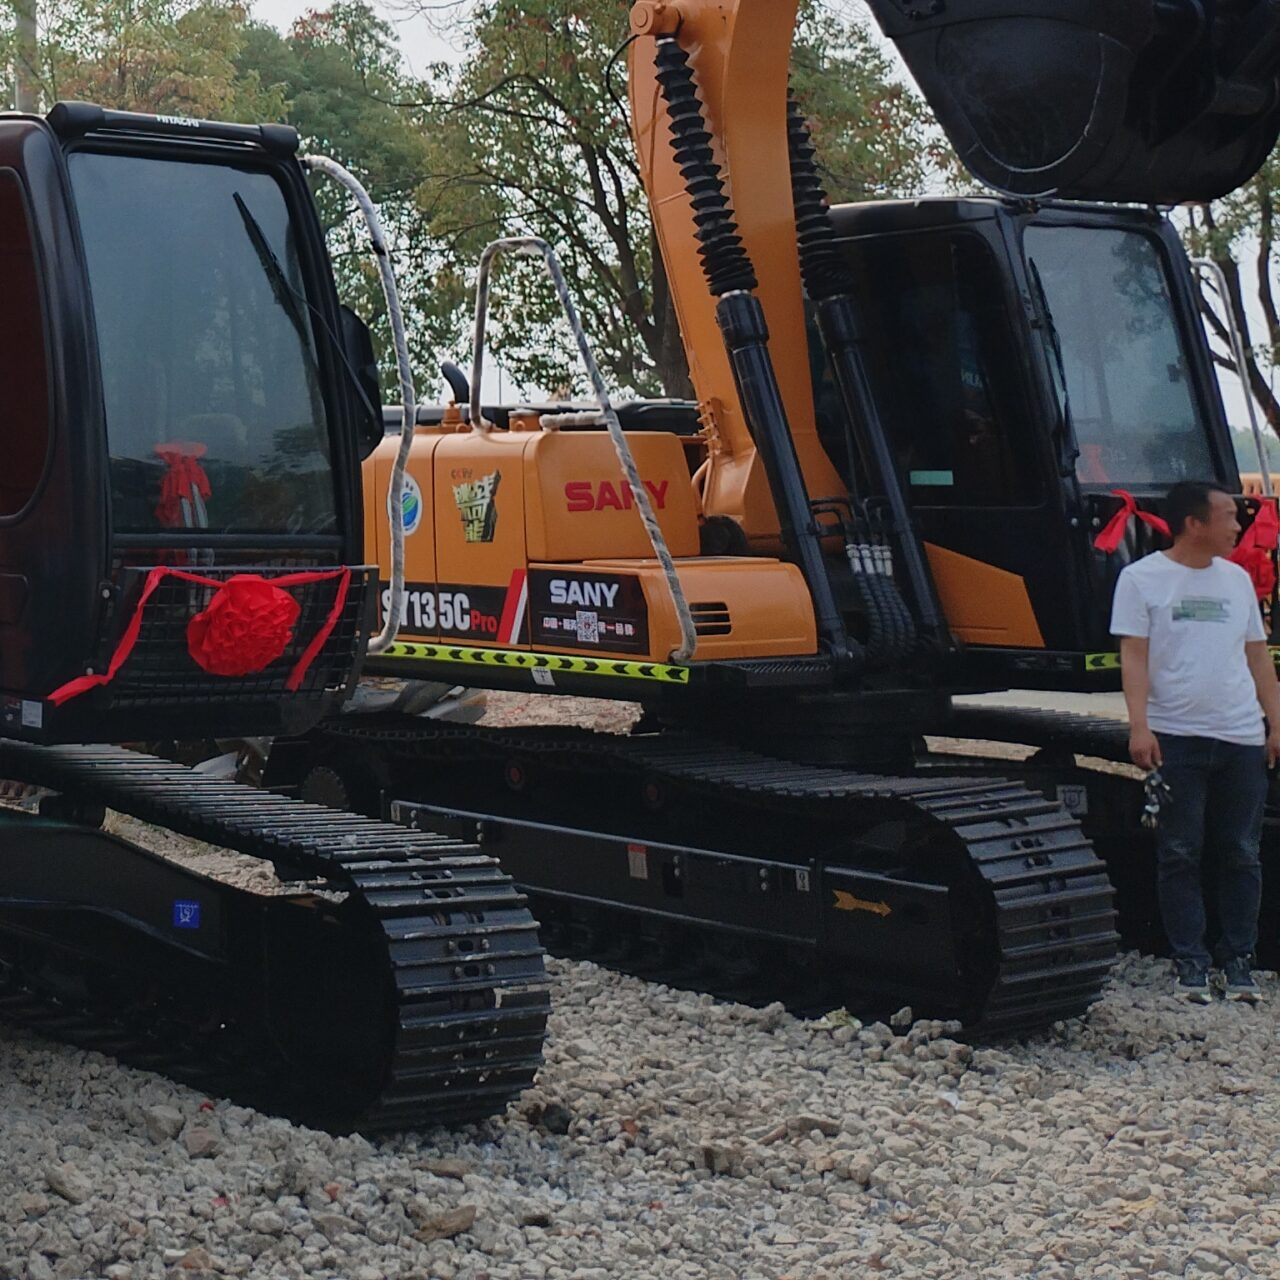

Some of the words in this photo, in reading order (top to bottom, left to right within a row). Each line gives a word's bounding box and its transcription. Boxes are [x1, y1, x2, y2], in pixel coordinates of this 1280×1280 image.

[565, 480, 669, 512] SANY
[549, 579, 620, 608] SANY
[470, 609, 498, 633] Pro
